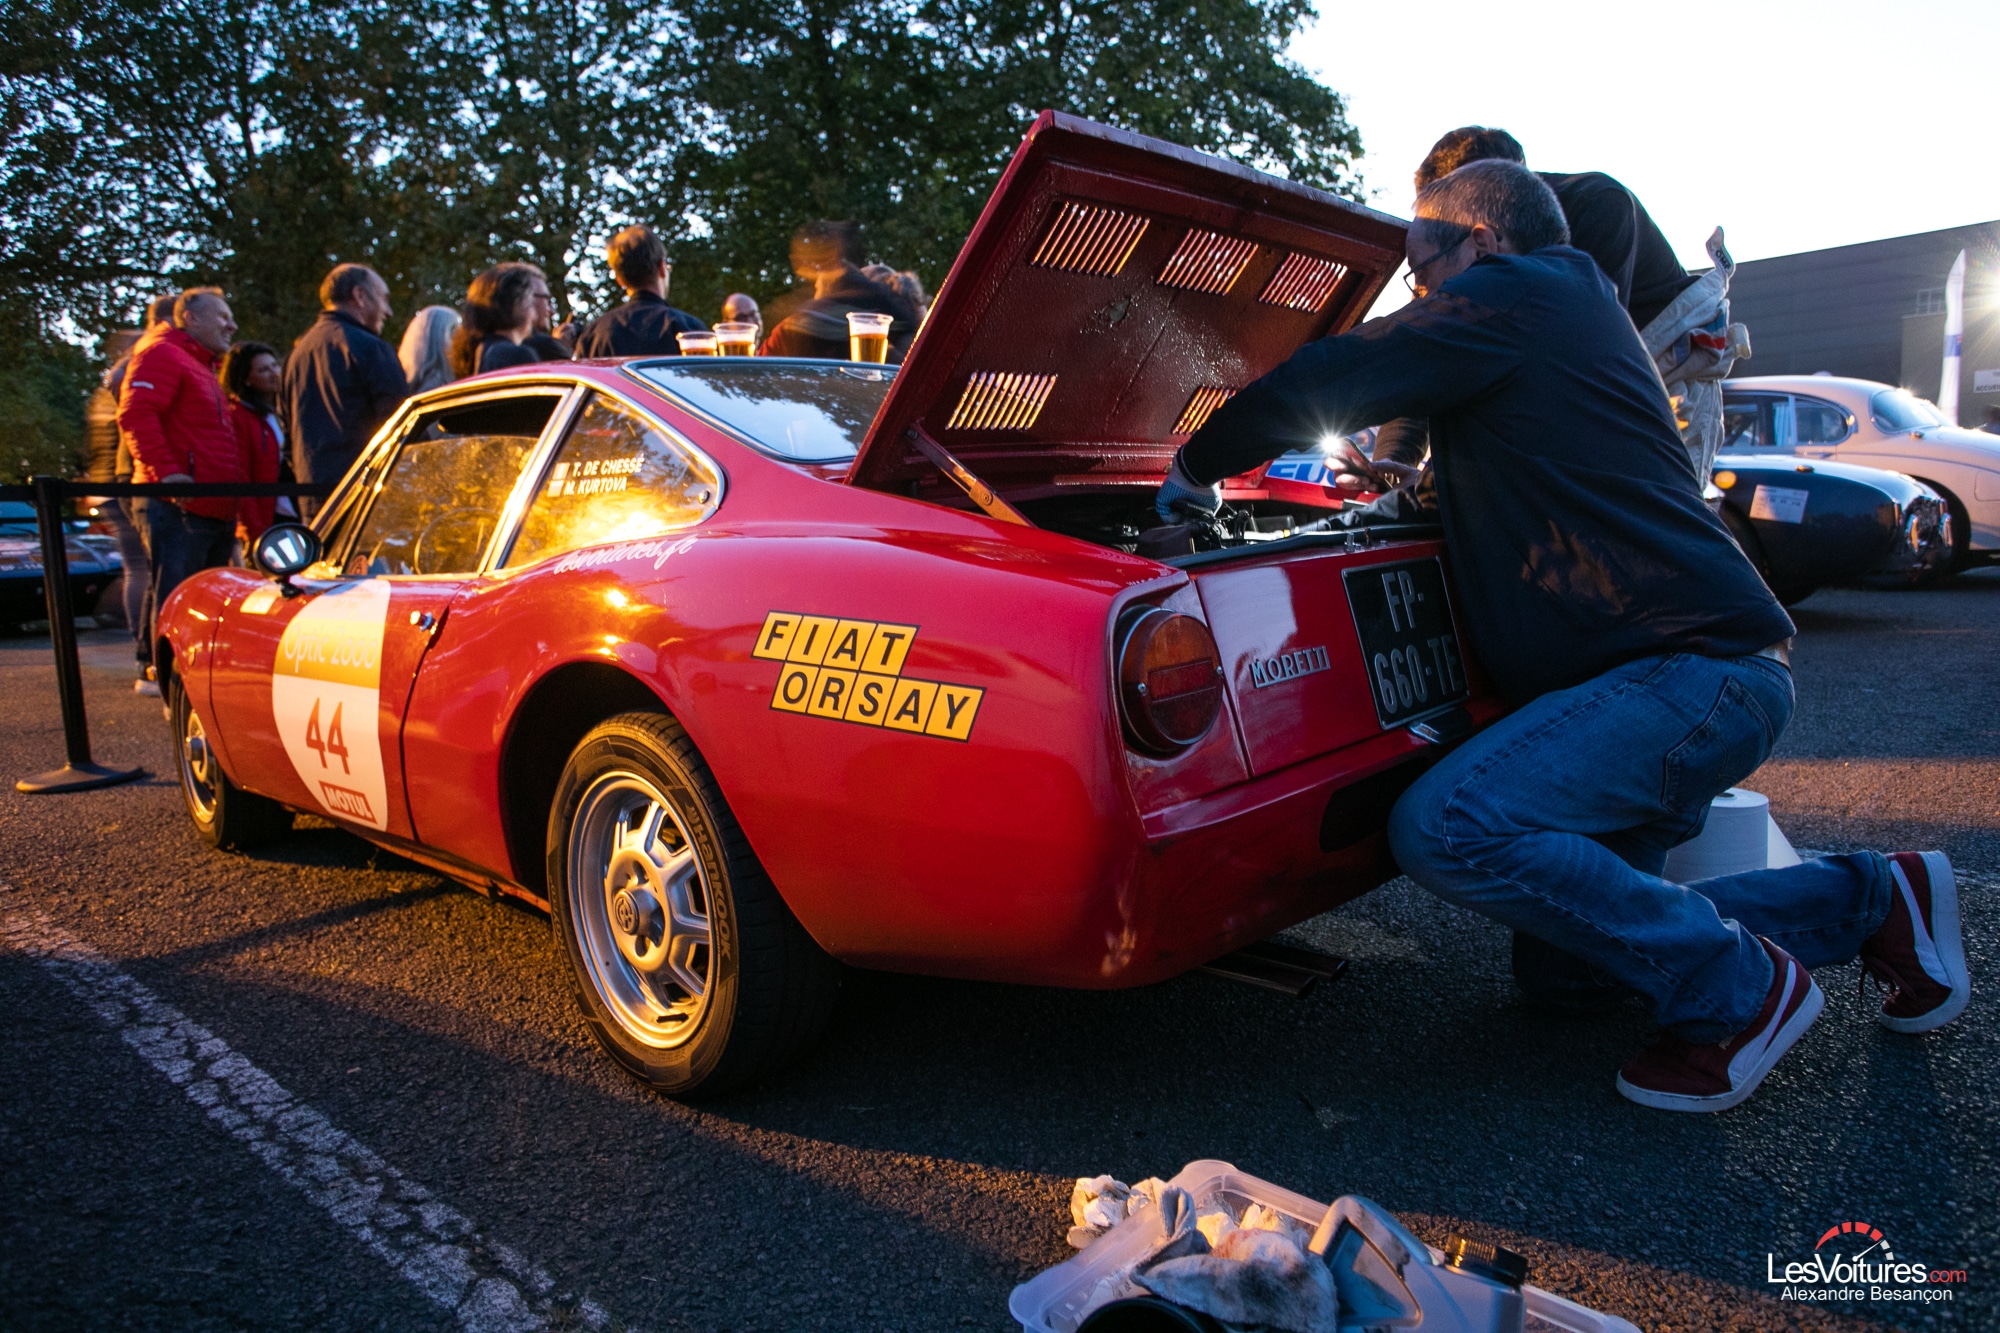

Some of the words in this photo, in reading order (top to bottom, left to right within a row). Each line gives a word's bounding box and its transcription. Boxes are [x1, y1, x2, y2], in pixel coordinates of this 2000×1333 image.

[572, 462, 582, 477] T.
[583, 460, 600, 476] DE
[577, 476, 627, 495] KURTOVA
[284, 622, 326, 673] Optic
[331, 628, 377, 670] 2000
[764, 620, 906, 666] FIAT
[1250, 645, 1331, 689] MORETTI
[782, 671, 970, 730] ORSAY
[306, 697, 350, 775] 44
[323, 784, 374, 819] MOTUL
